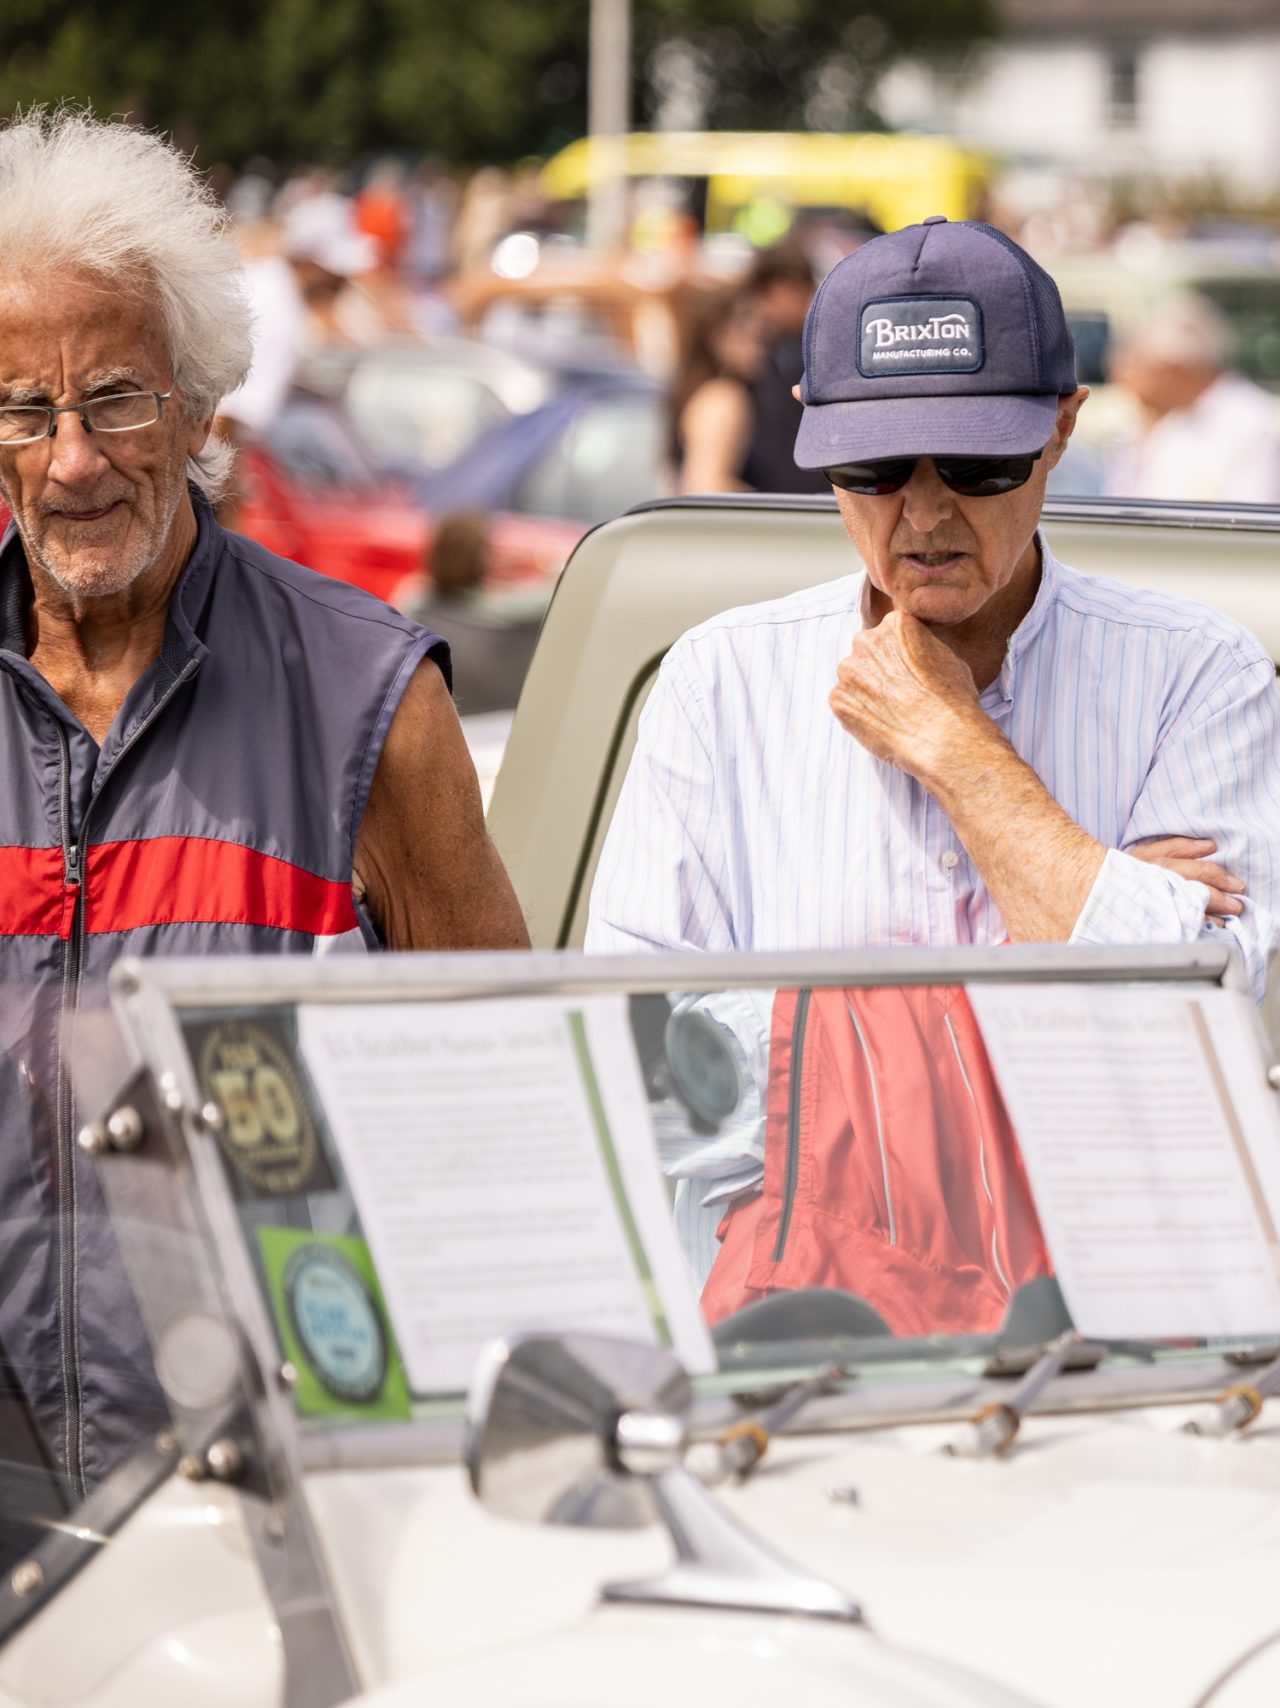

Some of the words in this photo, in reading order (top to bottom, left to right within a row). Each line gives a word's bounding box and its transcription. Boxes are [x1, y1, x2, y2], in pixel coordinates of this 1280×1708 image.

[865, 313, 970, 347] BRIXTON
[872, 348, 950, 360] MANUFACTURING
[952, 347, 972, 356] CO.
[213, 1066, 299, 1145] 50
